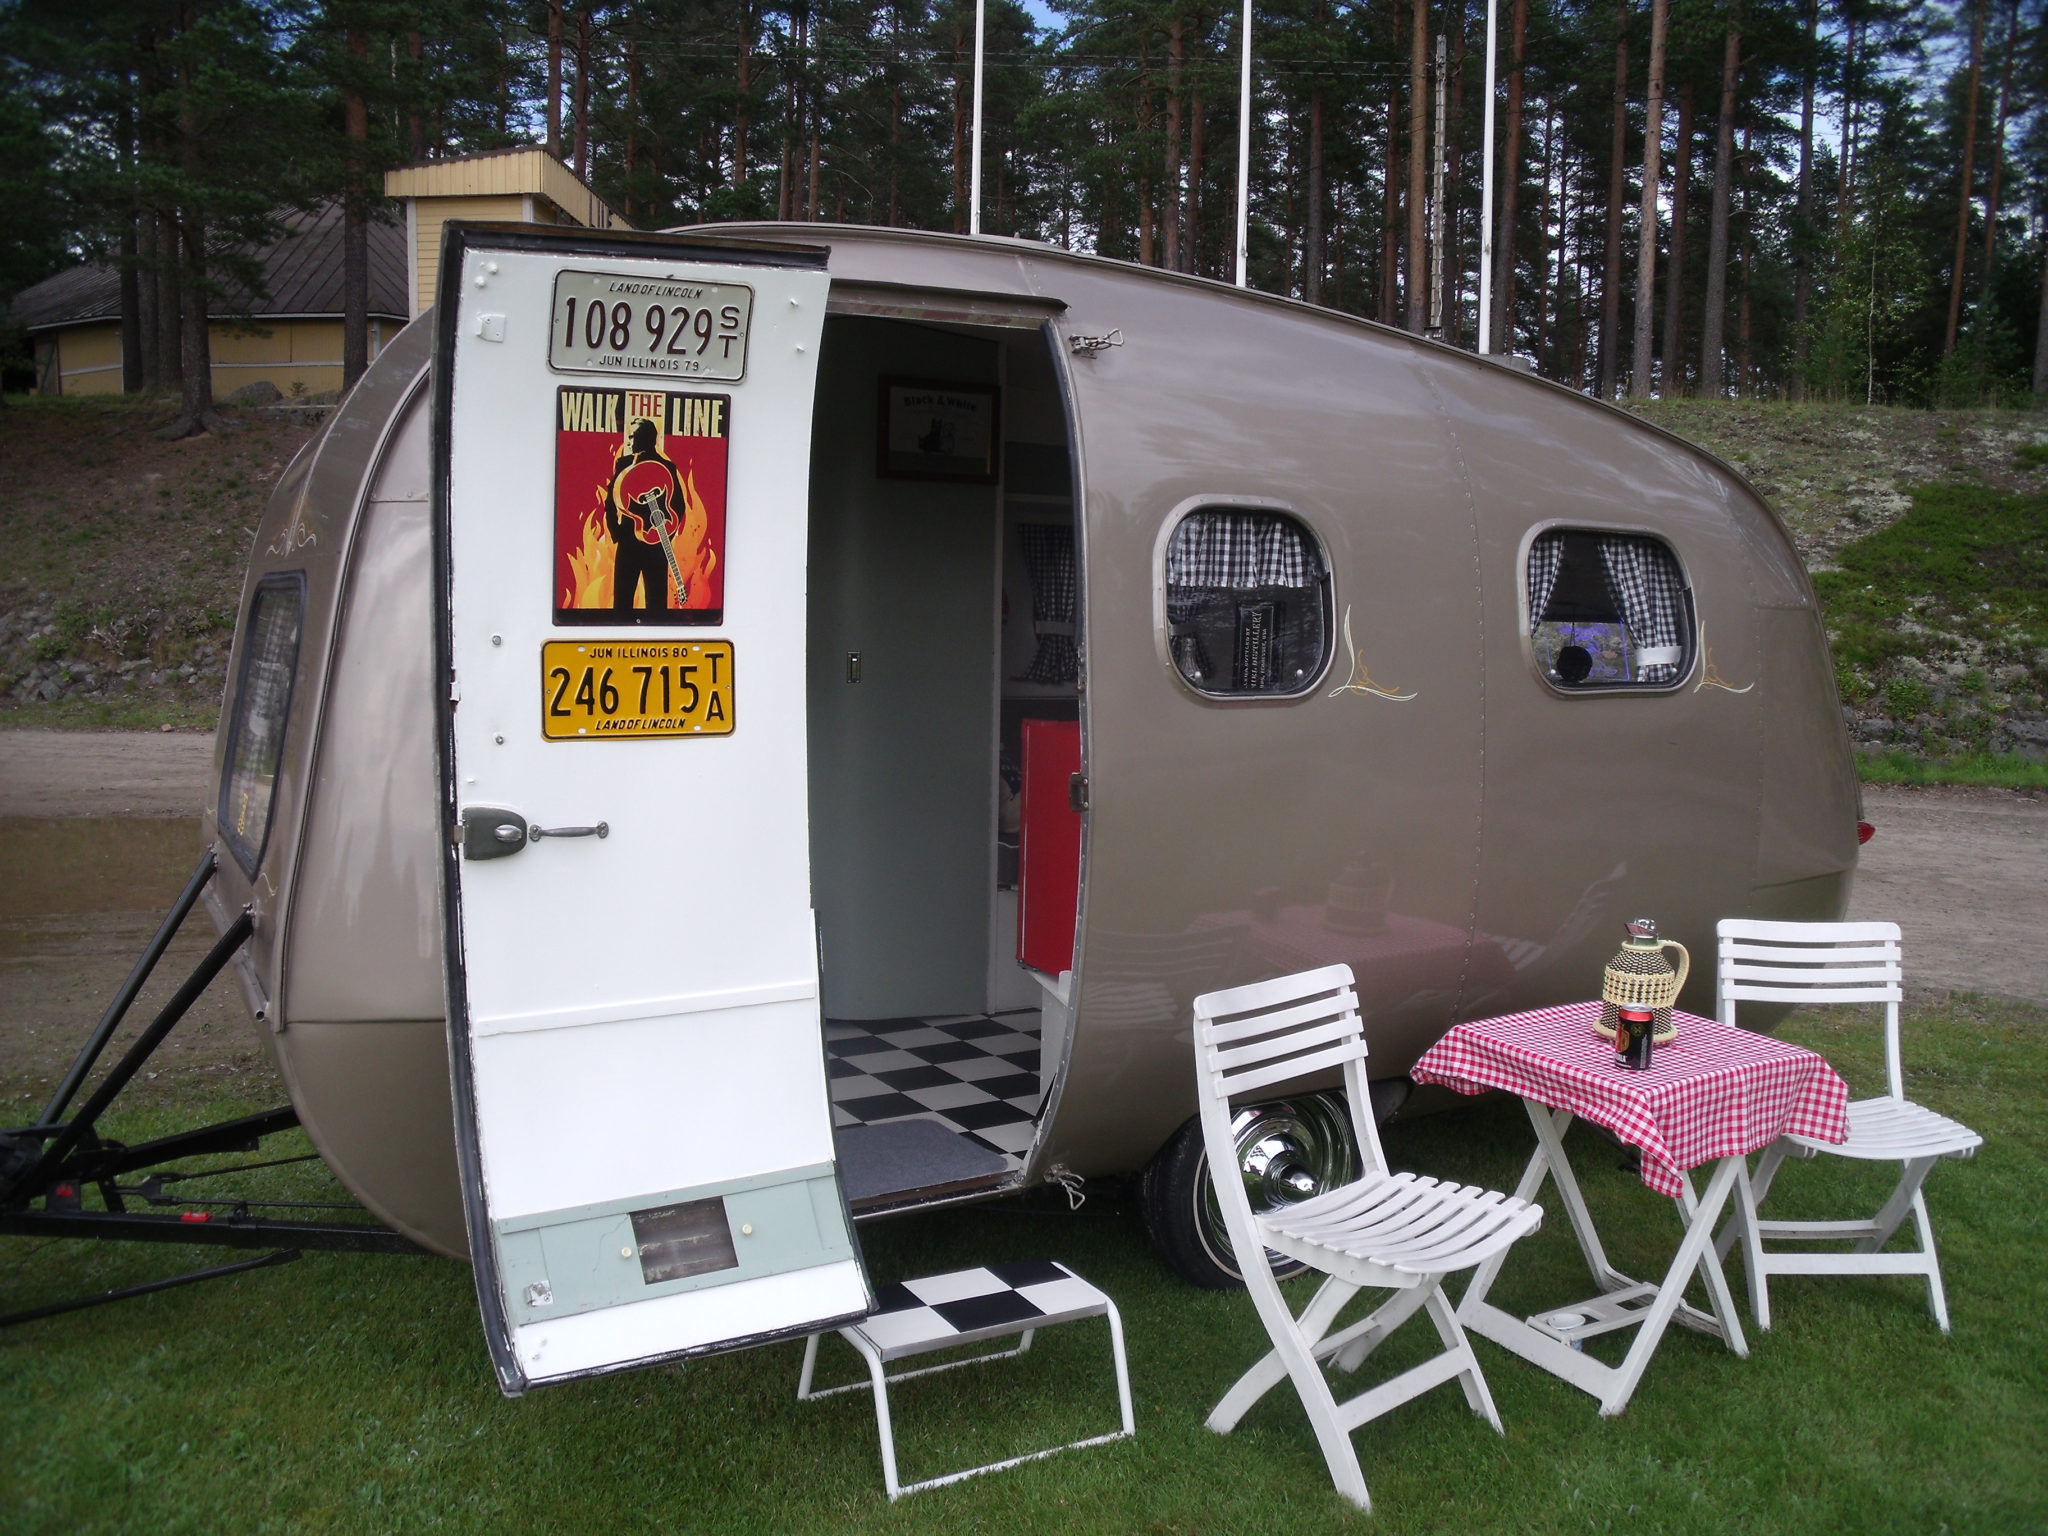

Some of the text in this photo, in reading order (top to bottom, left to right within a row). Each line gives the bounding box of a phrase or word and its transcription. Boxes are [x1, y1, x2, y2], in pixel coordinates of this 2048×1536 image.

[609, 282, 703, 299] LAND OF LINCOLN
[566, 297, 632, 351] 108
[645, 304, 713, 356] 929
[599, 354, 700, 371] JUN ILLINOIS 79
[561, 391, 724, 438] WALK THE LINE
[590, 647, 689, 659] JUN ILLINOIS 80
[550, 667, 620, 717] 246
[632, 666, 699, 714] 715
[595, 718, 686, 730] LAND OF LINCOLN
